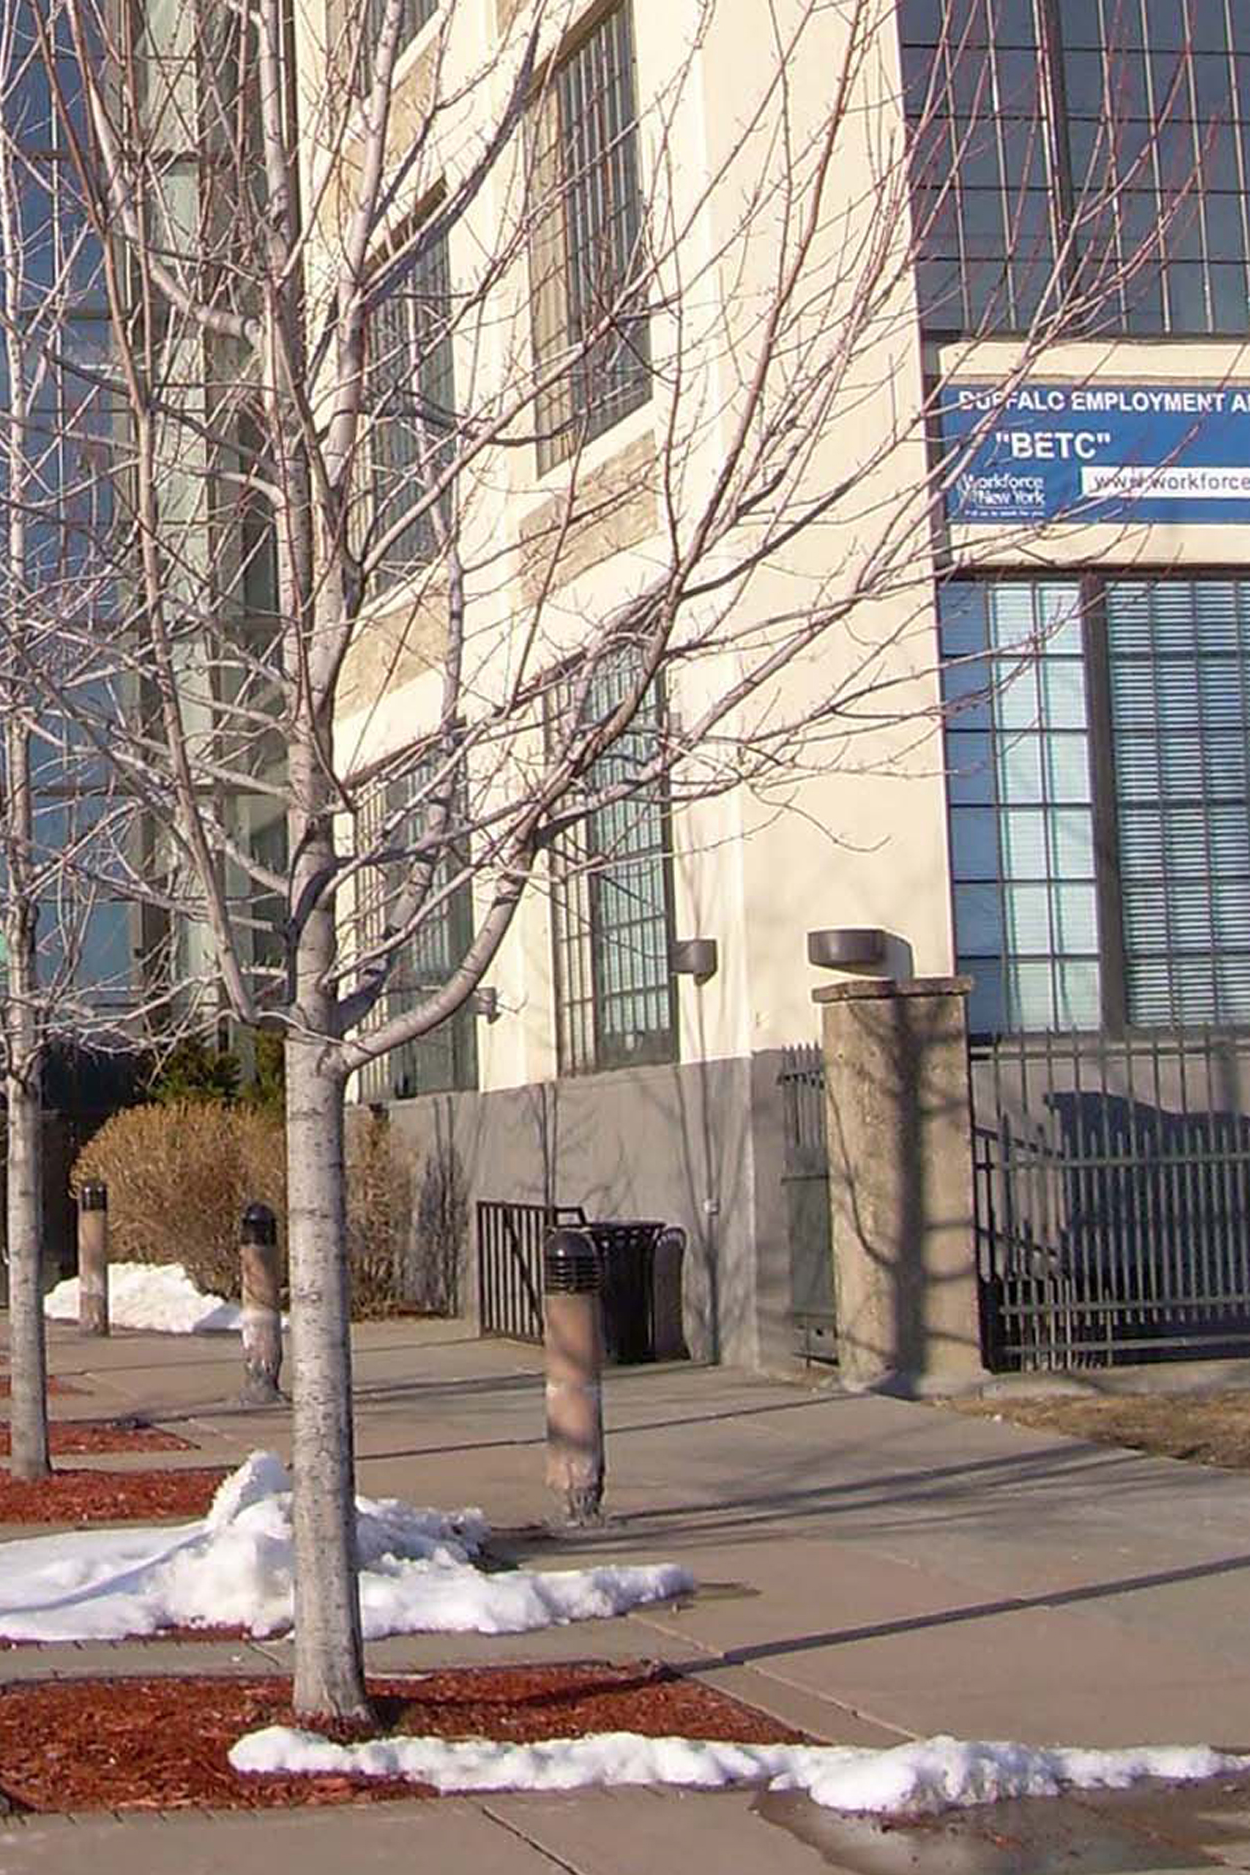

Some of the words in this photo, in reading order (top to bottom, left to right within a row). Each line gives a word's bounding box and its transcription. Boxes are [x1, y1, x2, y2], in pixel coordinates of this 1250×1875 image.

[1071, 391, 1225, 412] EMPLOYMENT
[996, 432, 1110, 459] "BETC"
[1095, 473, 1250, 489] wwwworkforce
[1012, 488, 1045, 507] York
